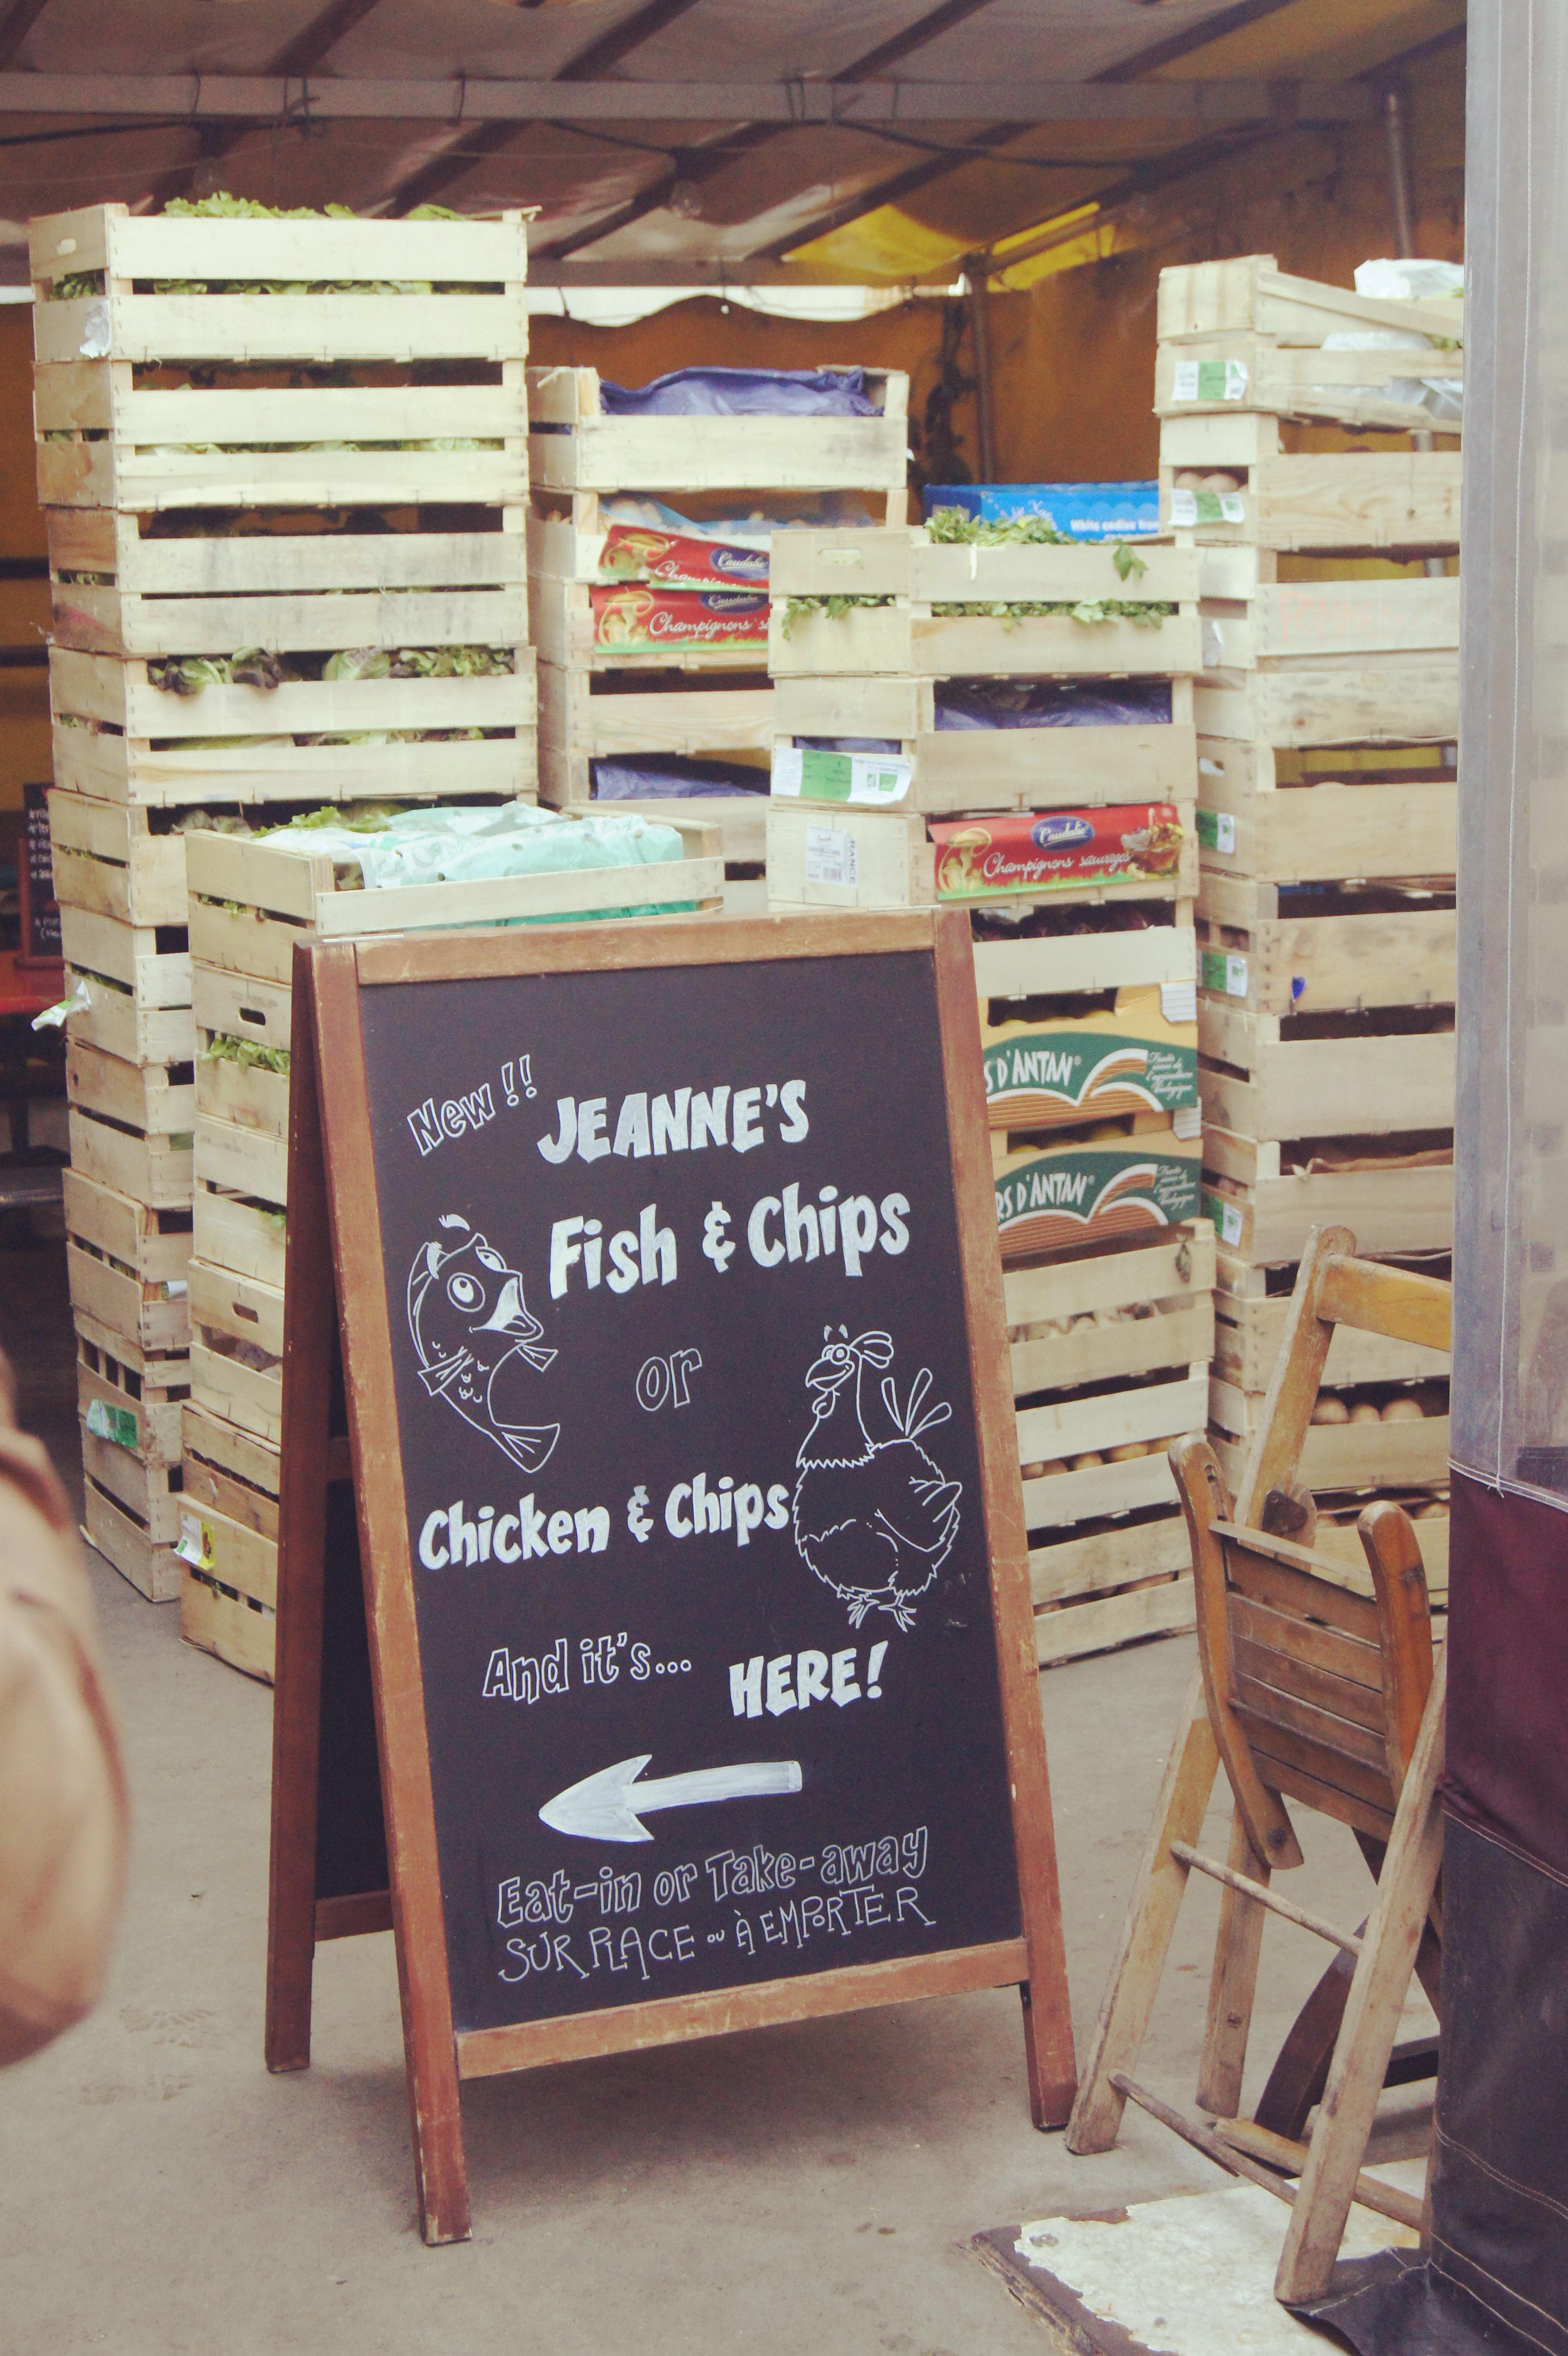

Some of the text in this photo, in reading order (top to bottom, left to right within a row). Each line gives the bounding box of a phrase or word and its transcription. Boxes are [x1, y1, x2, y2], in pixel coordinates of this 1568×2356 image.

[650, 612, 753, 639] Champignons
[983, 852, 1133, 880] Champignons sauvages
[996, 1048, 1073, 1089] D'ANTAN
[537, 1079, 809, 1164] JEANNE'S
[1016, 1172, 1087, 1212] D'ANTAN
[549, 1182, 910, 1300] Fish & Chips
[636, 1348, 702, 1411] or
[419, 1472, 789, 1570] Chicken & Chips
[482, 1638, 570, 1704] And
[729, 1640, 889, 1718] HERE!
[497, 1826, 928, 1928] Eat-in or Take-away
[499, 1932, 590, 1981] SUR
[589, 1925, 694, 1979] PLACE
[734, 1910, 755, 1955] À
[760, 1884, 935, 1948] EMPORTER
